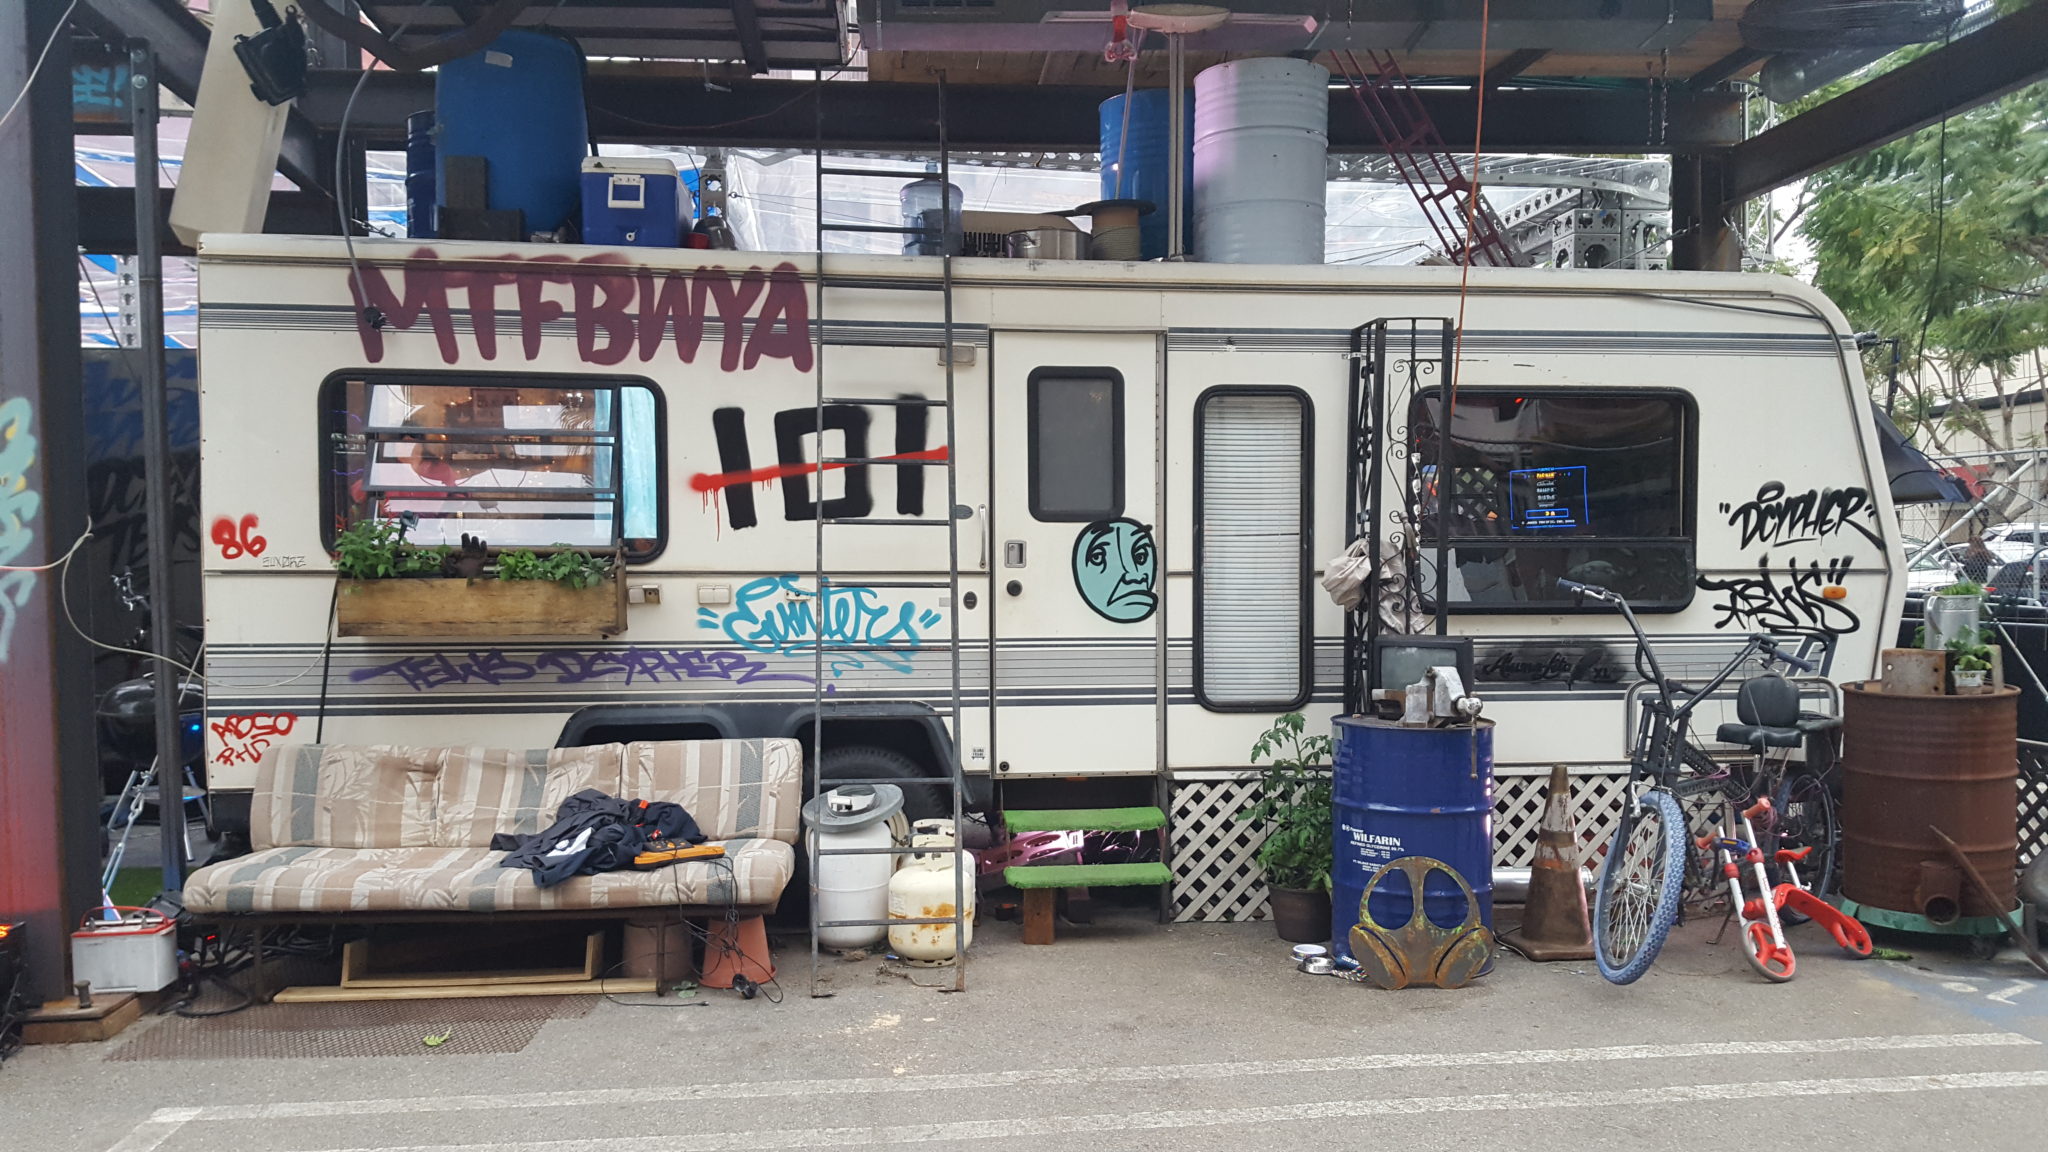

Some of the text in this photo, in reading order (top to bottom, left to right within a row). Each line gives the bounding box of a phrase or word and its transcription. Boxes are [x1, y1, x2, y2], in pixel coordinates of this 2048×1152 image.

[348, 247, 814, 373] MTFBWYA
[211, 513, 267, 560] 86
[1353, 832, 1401, 846] WILFARIN
